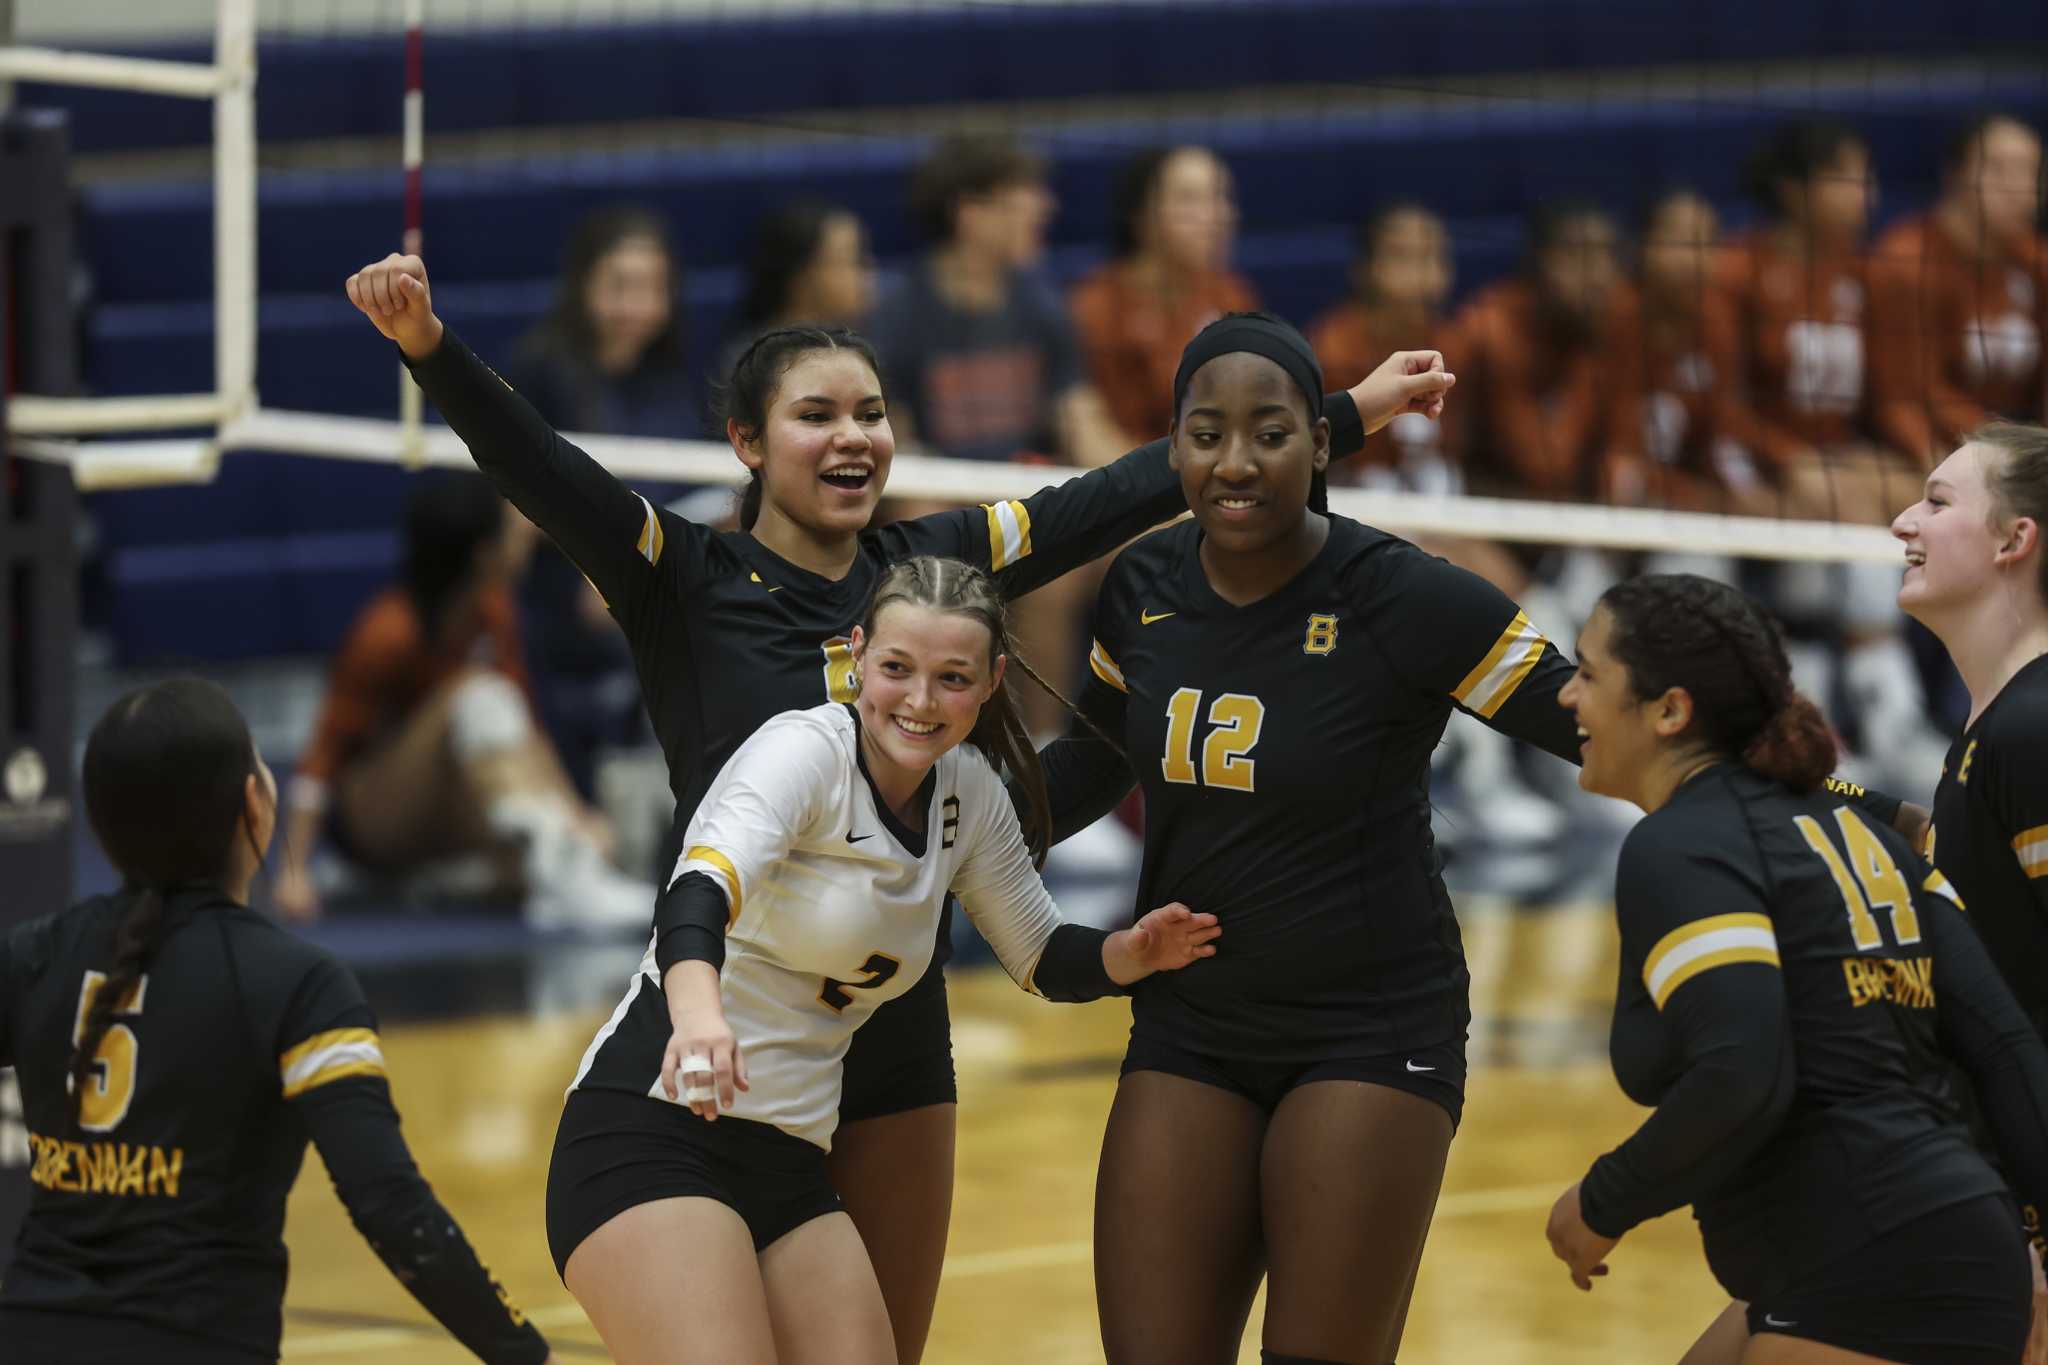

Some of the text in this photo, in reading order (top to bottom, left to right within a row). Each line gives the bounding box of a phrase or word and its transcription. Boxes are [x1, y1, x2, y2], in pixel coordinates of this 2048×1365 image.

[1303, 613, 1339, 657] B
[1161, 687, 1265, 793] 12
[1792, 805, 1922, 952] 14
[816, 951, 902, 1016] 2
[66, 970, 149, 1132] 5
